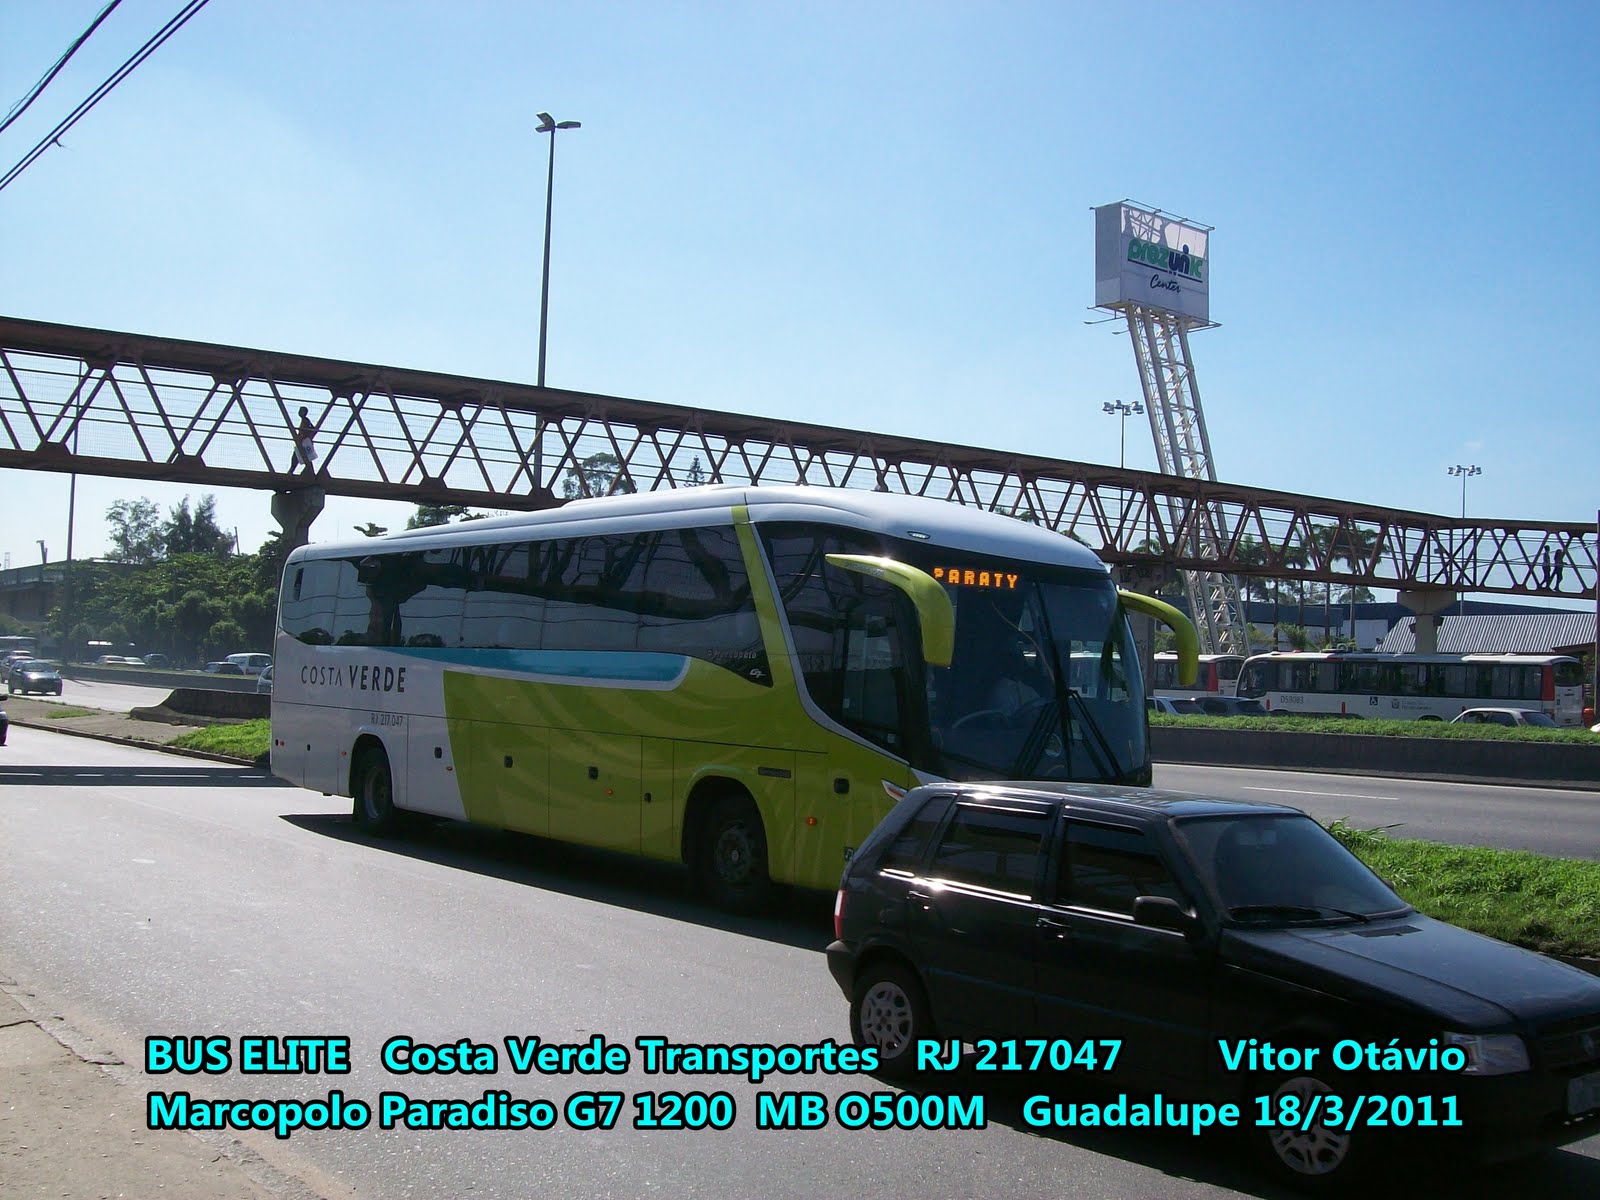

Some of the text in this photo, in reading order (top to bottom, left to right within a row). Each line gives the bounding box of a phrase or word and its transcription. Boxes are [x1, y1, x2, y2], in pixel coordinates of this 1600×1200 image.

[1149, 273, 1182, 294] Center
[933, 567, 1018, 589] PARATY
[301, 665, 407, 693] COSTA VERDE
